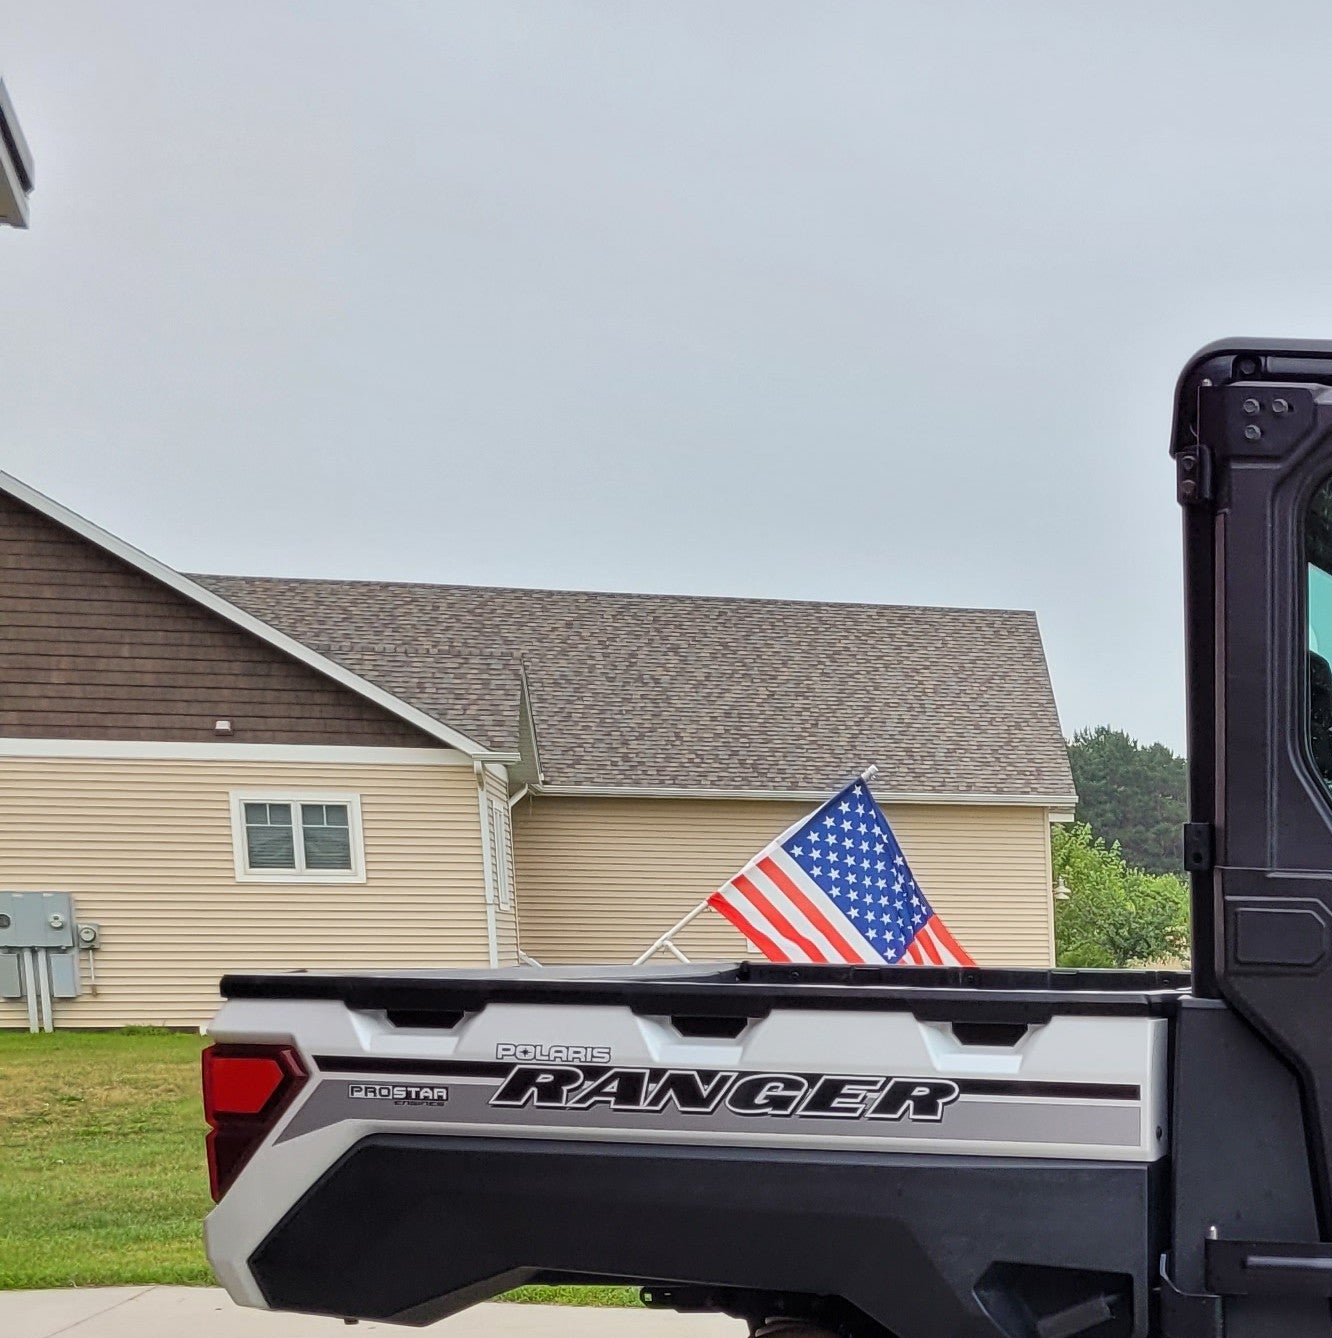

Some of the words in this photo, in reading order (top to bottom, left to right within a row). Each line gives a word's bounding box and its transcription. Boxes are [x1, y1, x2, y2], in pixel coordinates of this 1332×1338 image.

[496, 1043, 611, 1064] POLARIS
[350, 1085, 448, 1101] PROSTAR
[488, 1064, 961, 1123] RANGER
